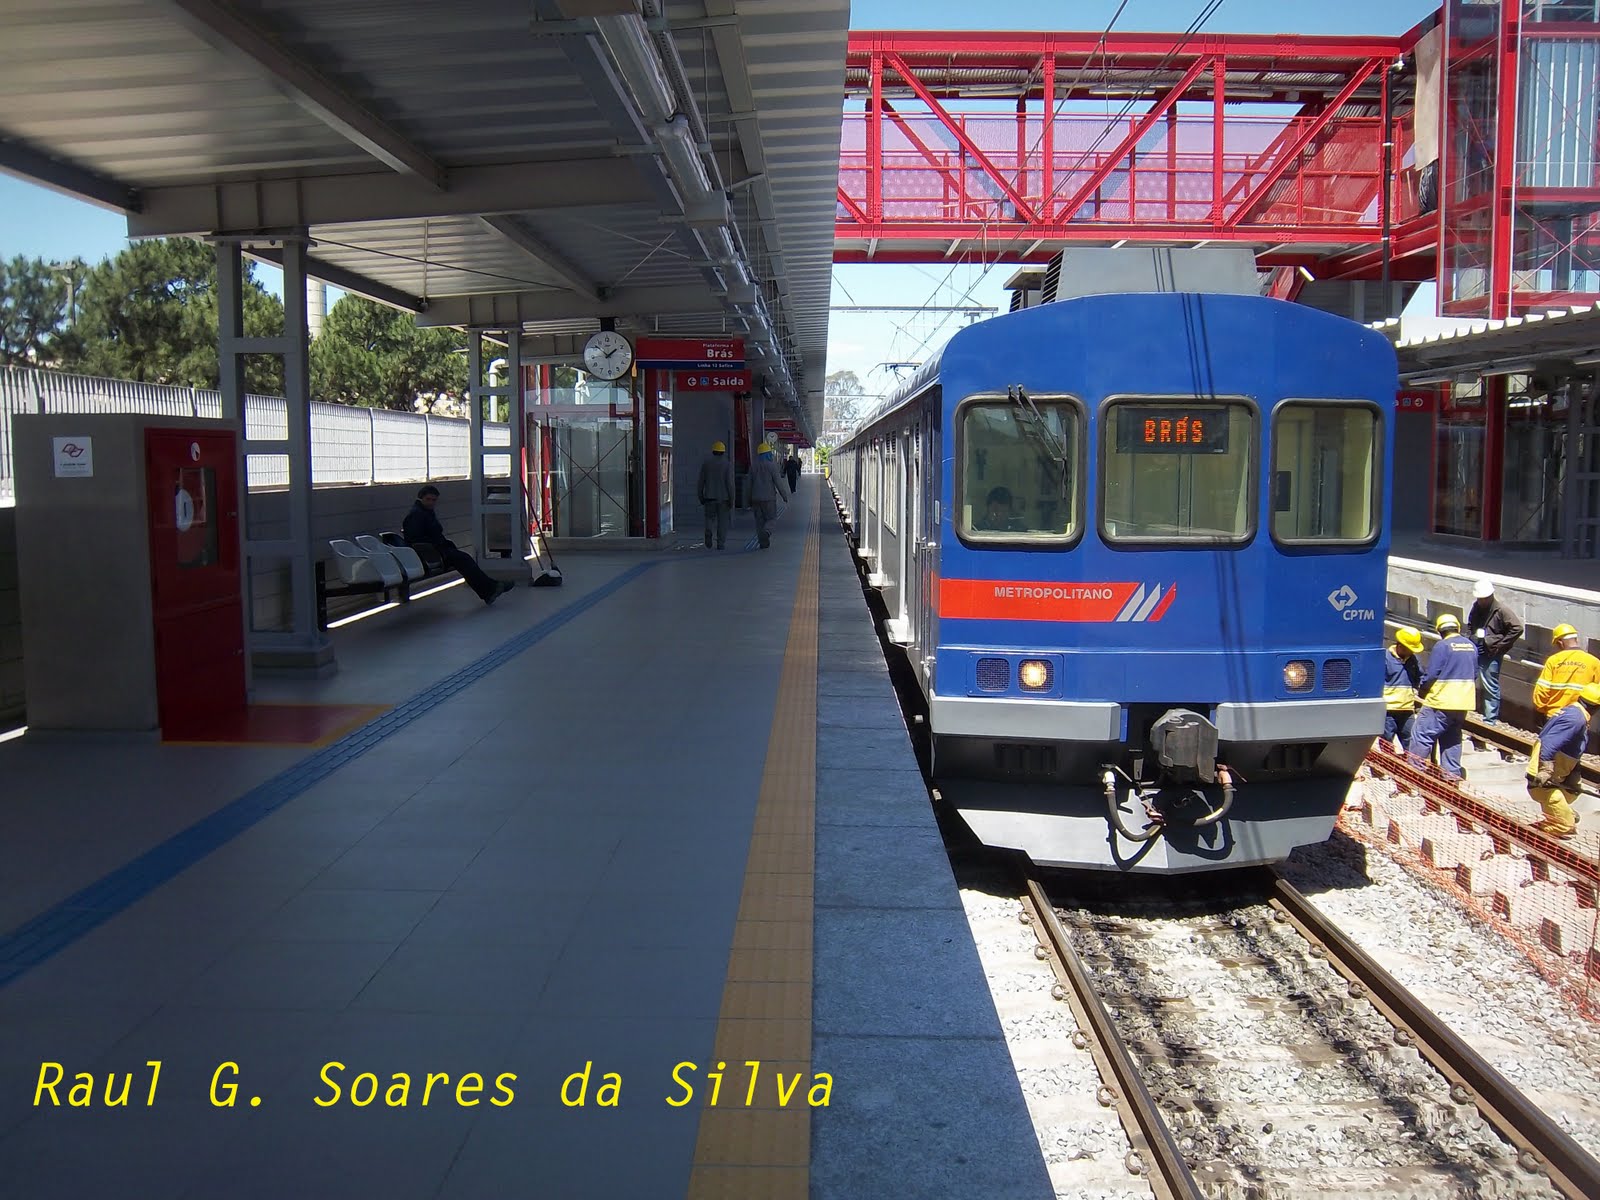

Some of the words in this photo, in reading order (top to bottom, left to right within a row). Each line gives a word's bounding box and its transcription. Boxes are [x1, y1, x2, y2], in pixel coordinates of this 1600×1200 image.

[706, 348, 734, 358] Brás
[712, 376, 744, 386] Saída
[1144, 416, 1203, 443] BRÁS
[994, 586, 1113, 600] METROPOLITANO
[1343, 609, 1375, 621] CPTM
